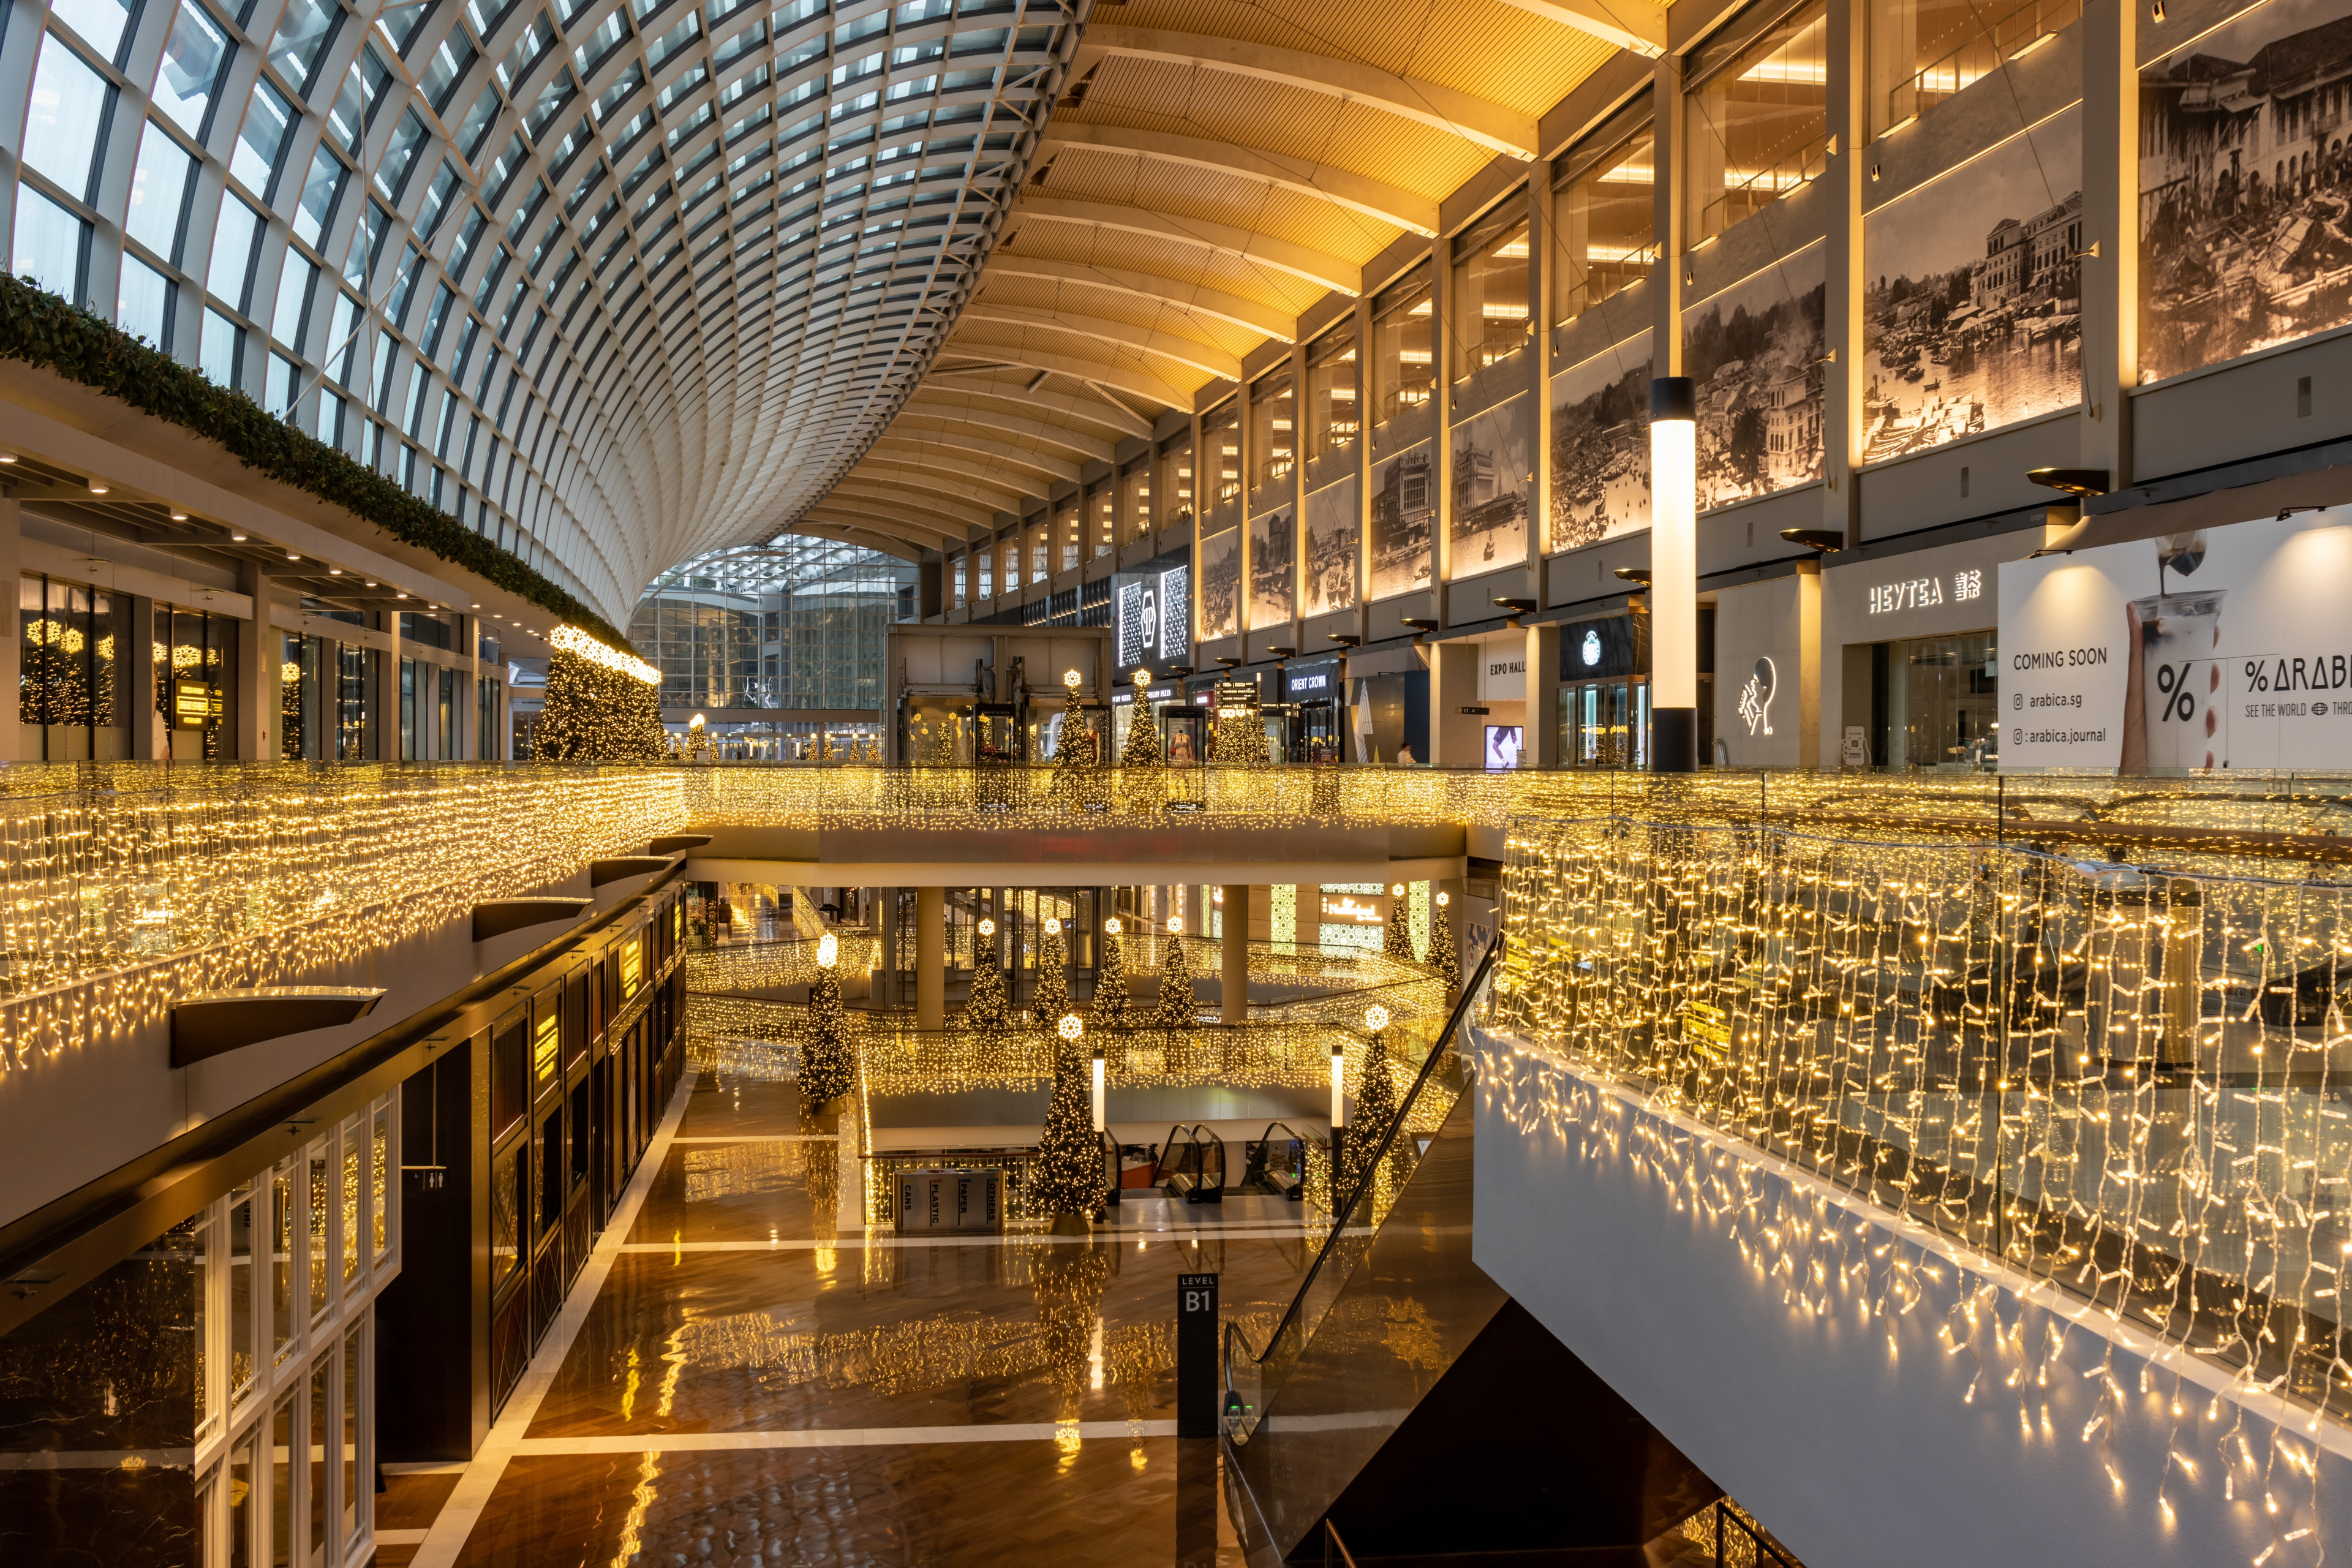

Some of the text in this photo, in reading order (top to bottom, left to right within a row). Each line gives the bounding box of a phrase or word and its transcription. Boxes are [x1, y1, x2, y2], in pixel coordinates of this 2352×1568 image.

[1869, 577, 1943, 614] HEYTEA
[2014, 647, 2107, 671] COMING SOON
[1490, 663, 1507, 676] EXPO
[2245, 660, 2268, 693] %
[1291, 674, 1326, 691] ORIENT CROWN
[2030, 693, 2082, 708] arabica.sg
[2245, 704, 2259, 717] SEE
[2261, 704, 2275, 717] THE
[2277, 703, 2307, 717] WORLD
[1182, 1276, 1214, 1285] LEVEL
[1186, 1290, 1210, 1312] B1
